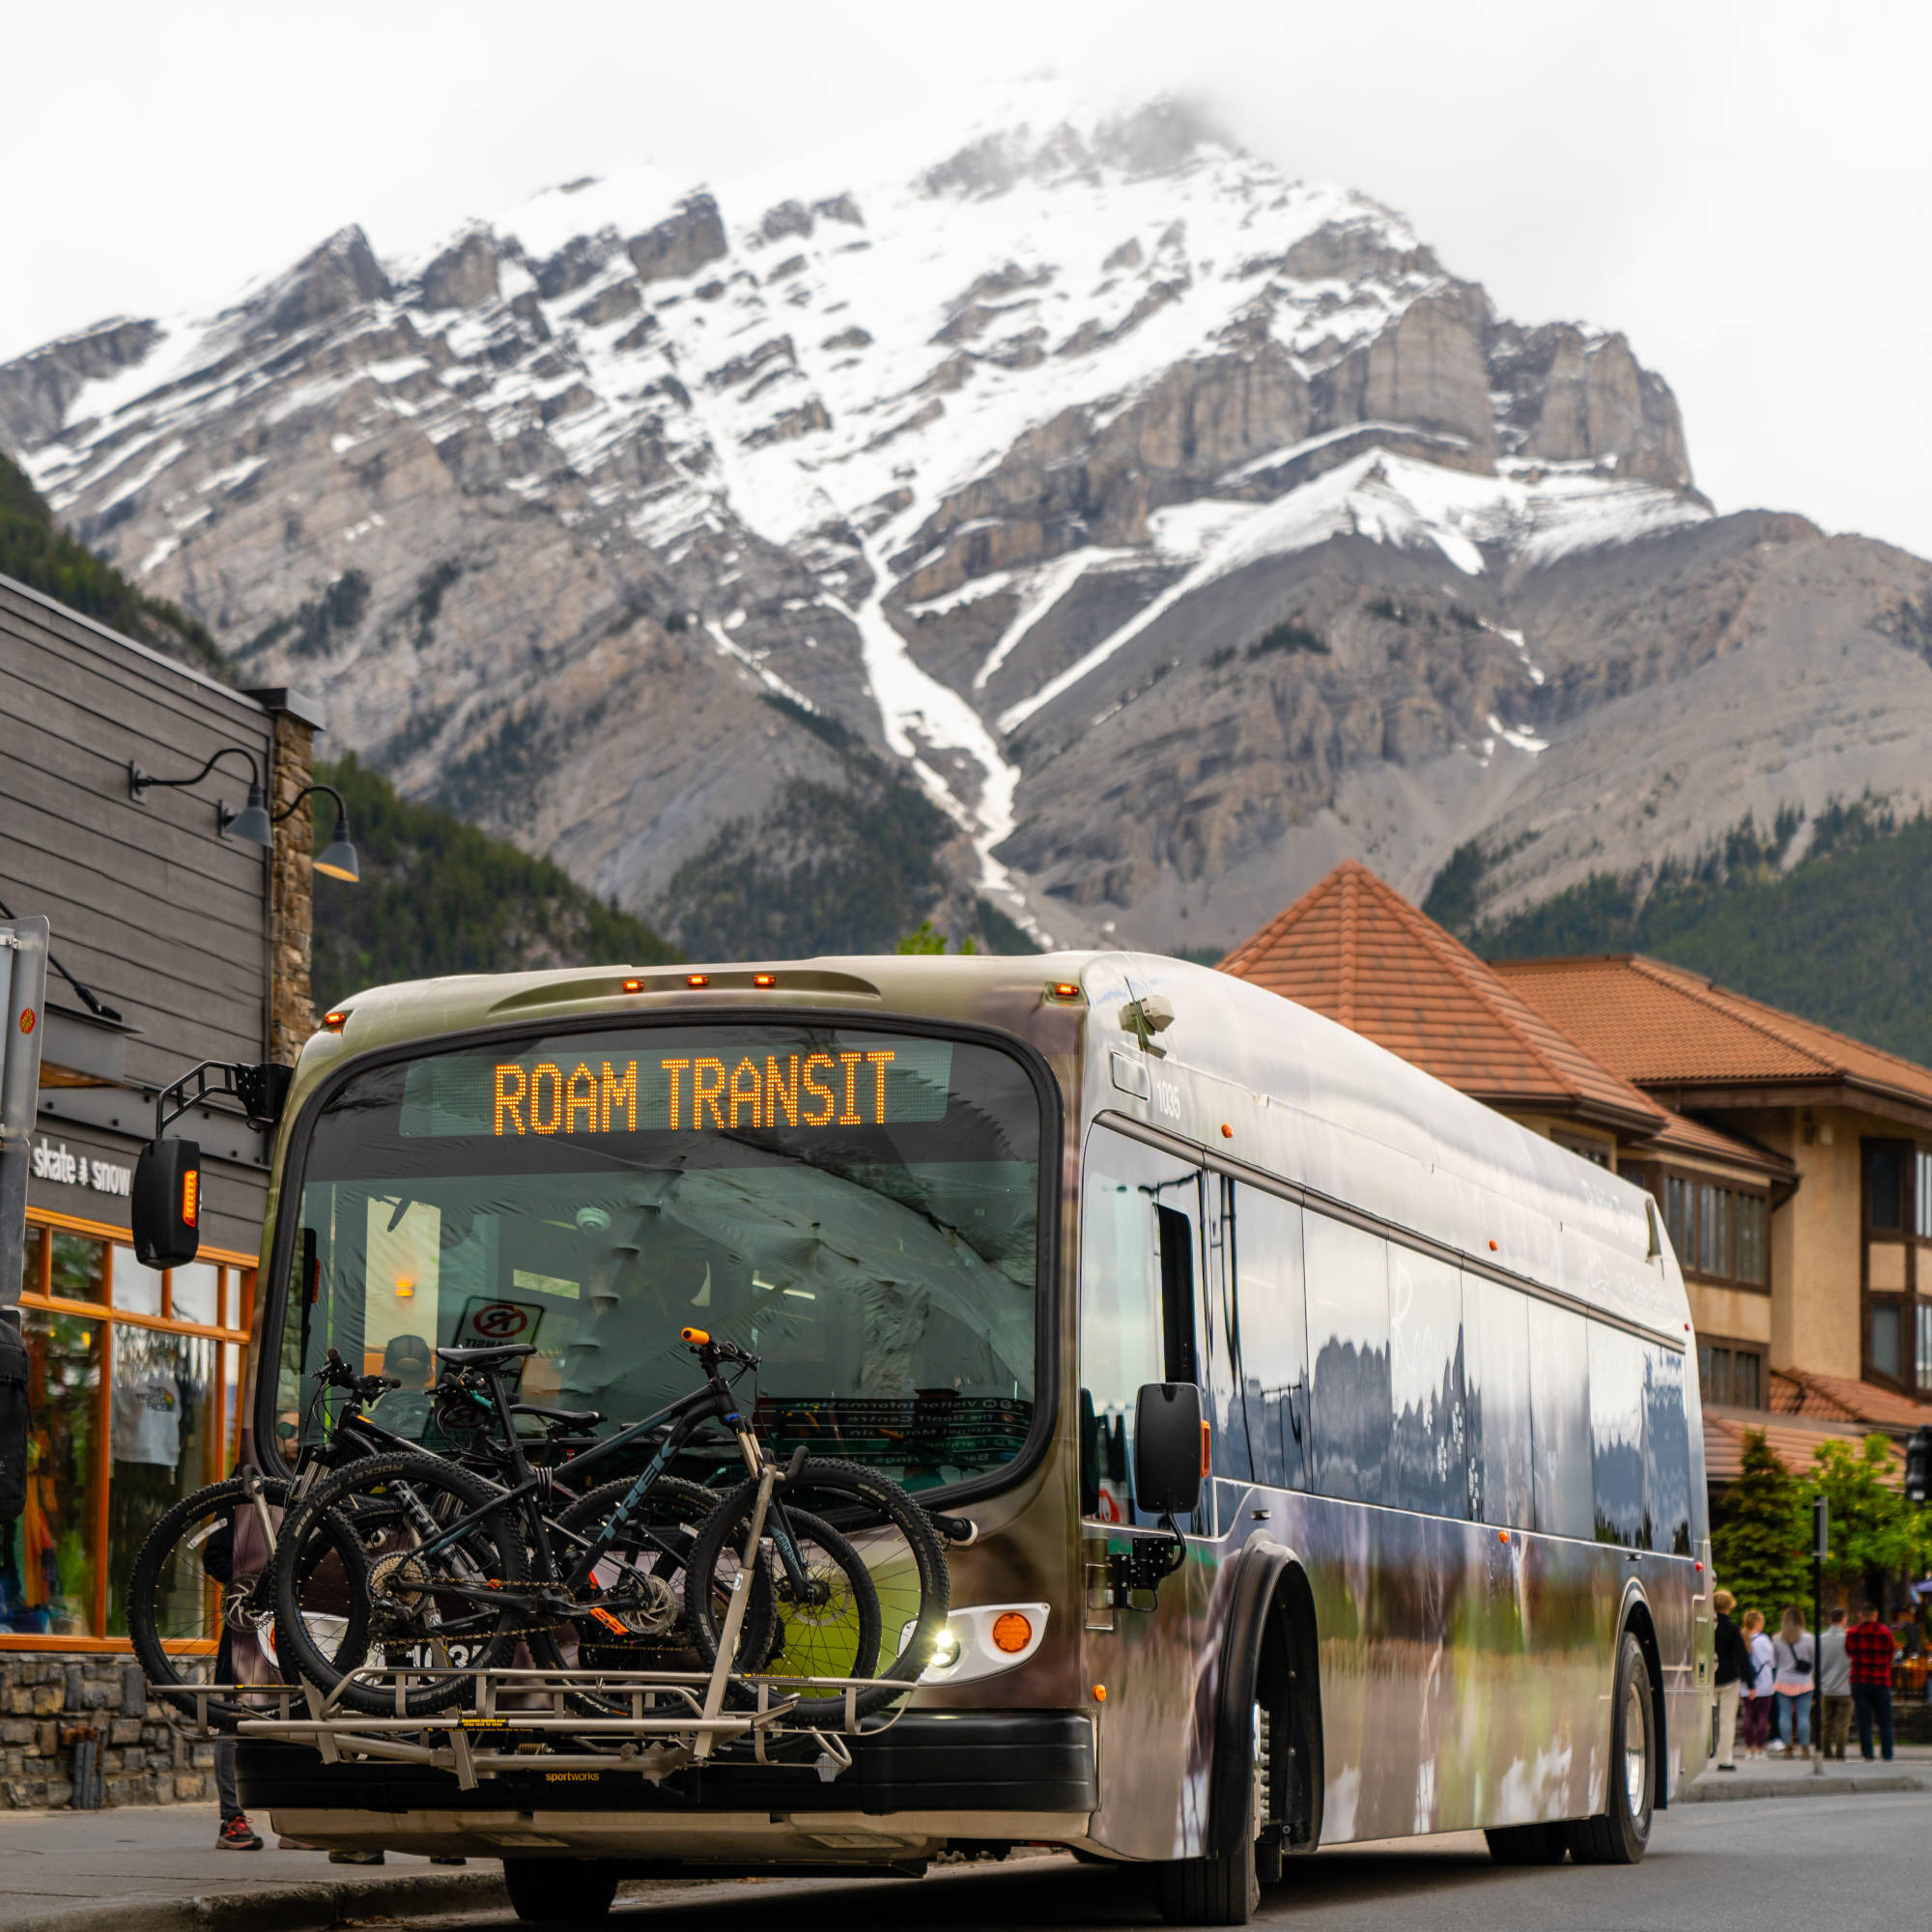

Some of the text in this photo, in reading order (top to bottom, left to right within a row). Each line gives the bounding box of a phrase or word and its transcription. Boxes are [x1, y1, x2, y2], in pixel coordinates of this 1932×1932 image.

[494, 1050, 895, 1136] ROAM TRANSIT
[1157, 1078, 1181, 1121] 1035
[33, 1137, 77, 1184] skate
[92, 1160, 132, 1197] snow
[596, 1436, 679, 1544] TREK
[545, 1772, 600, 1783] sportworks
